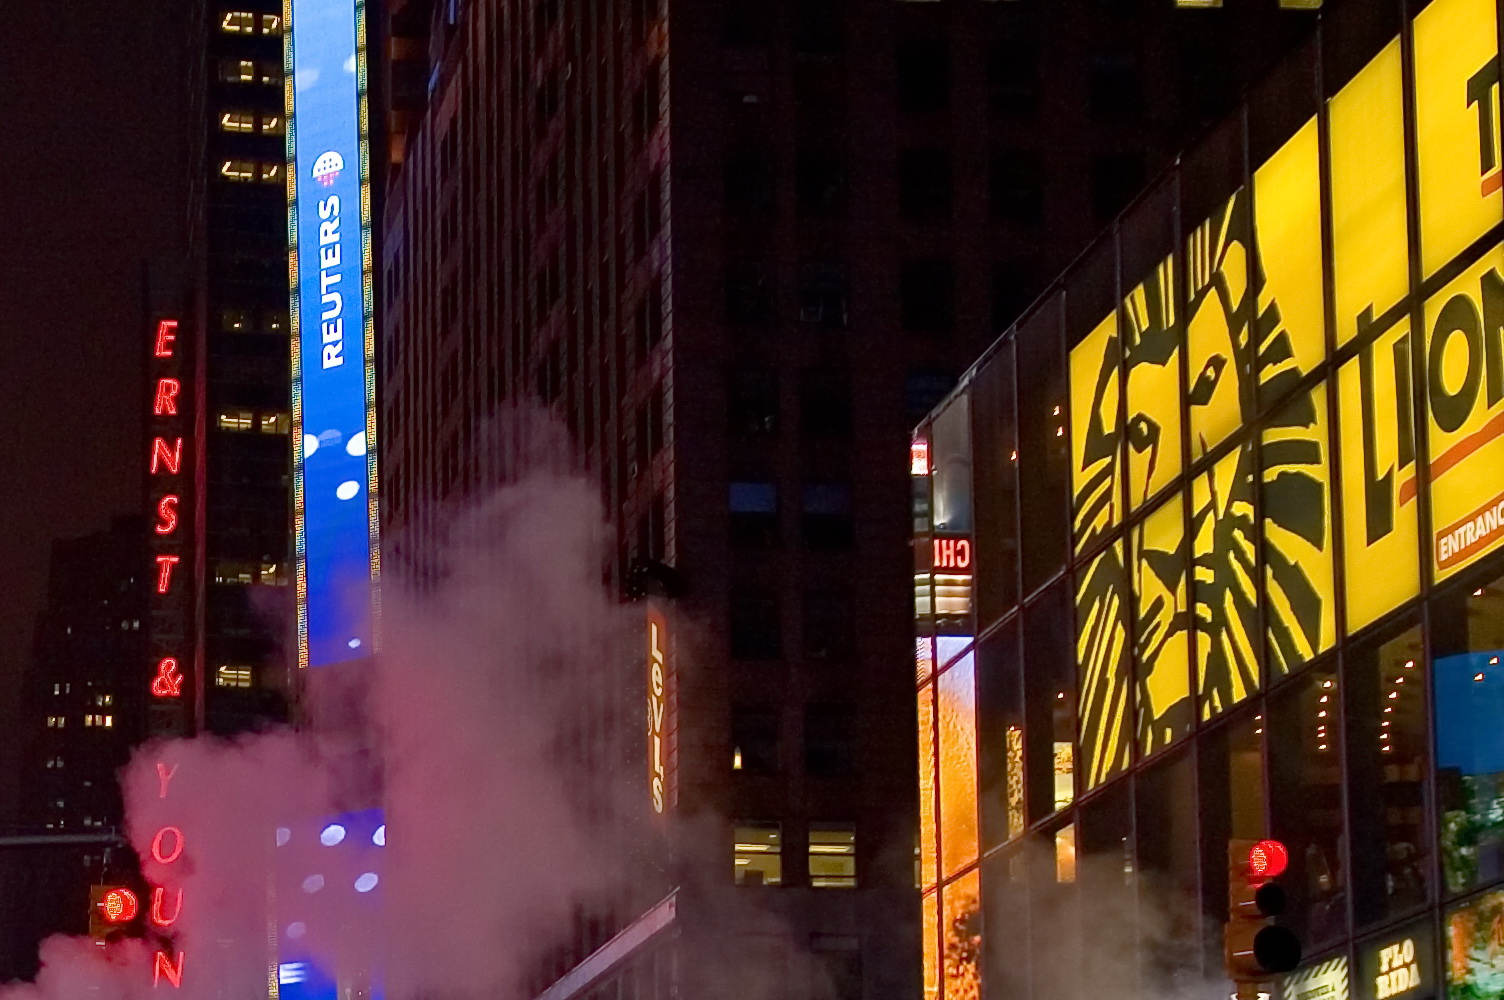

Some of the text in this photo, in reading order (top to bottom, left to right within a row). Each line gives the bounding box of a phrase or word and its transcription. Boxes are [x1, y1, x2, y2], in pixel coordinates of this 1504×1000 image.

[318, 194, 345, 370] REUTERS
[151, 320, 182, 594] ERNST
[152, 657, 183, 696] &
[1379, 938, 1415, 973] FLO
